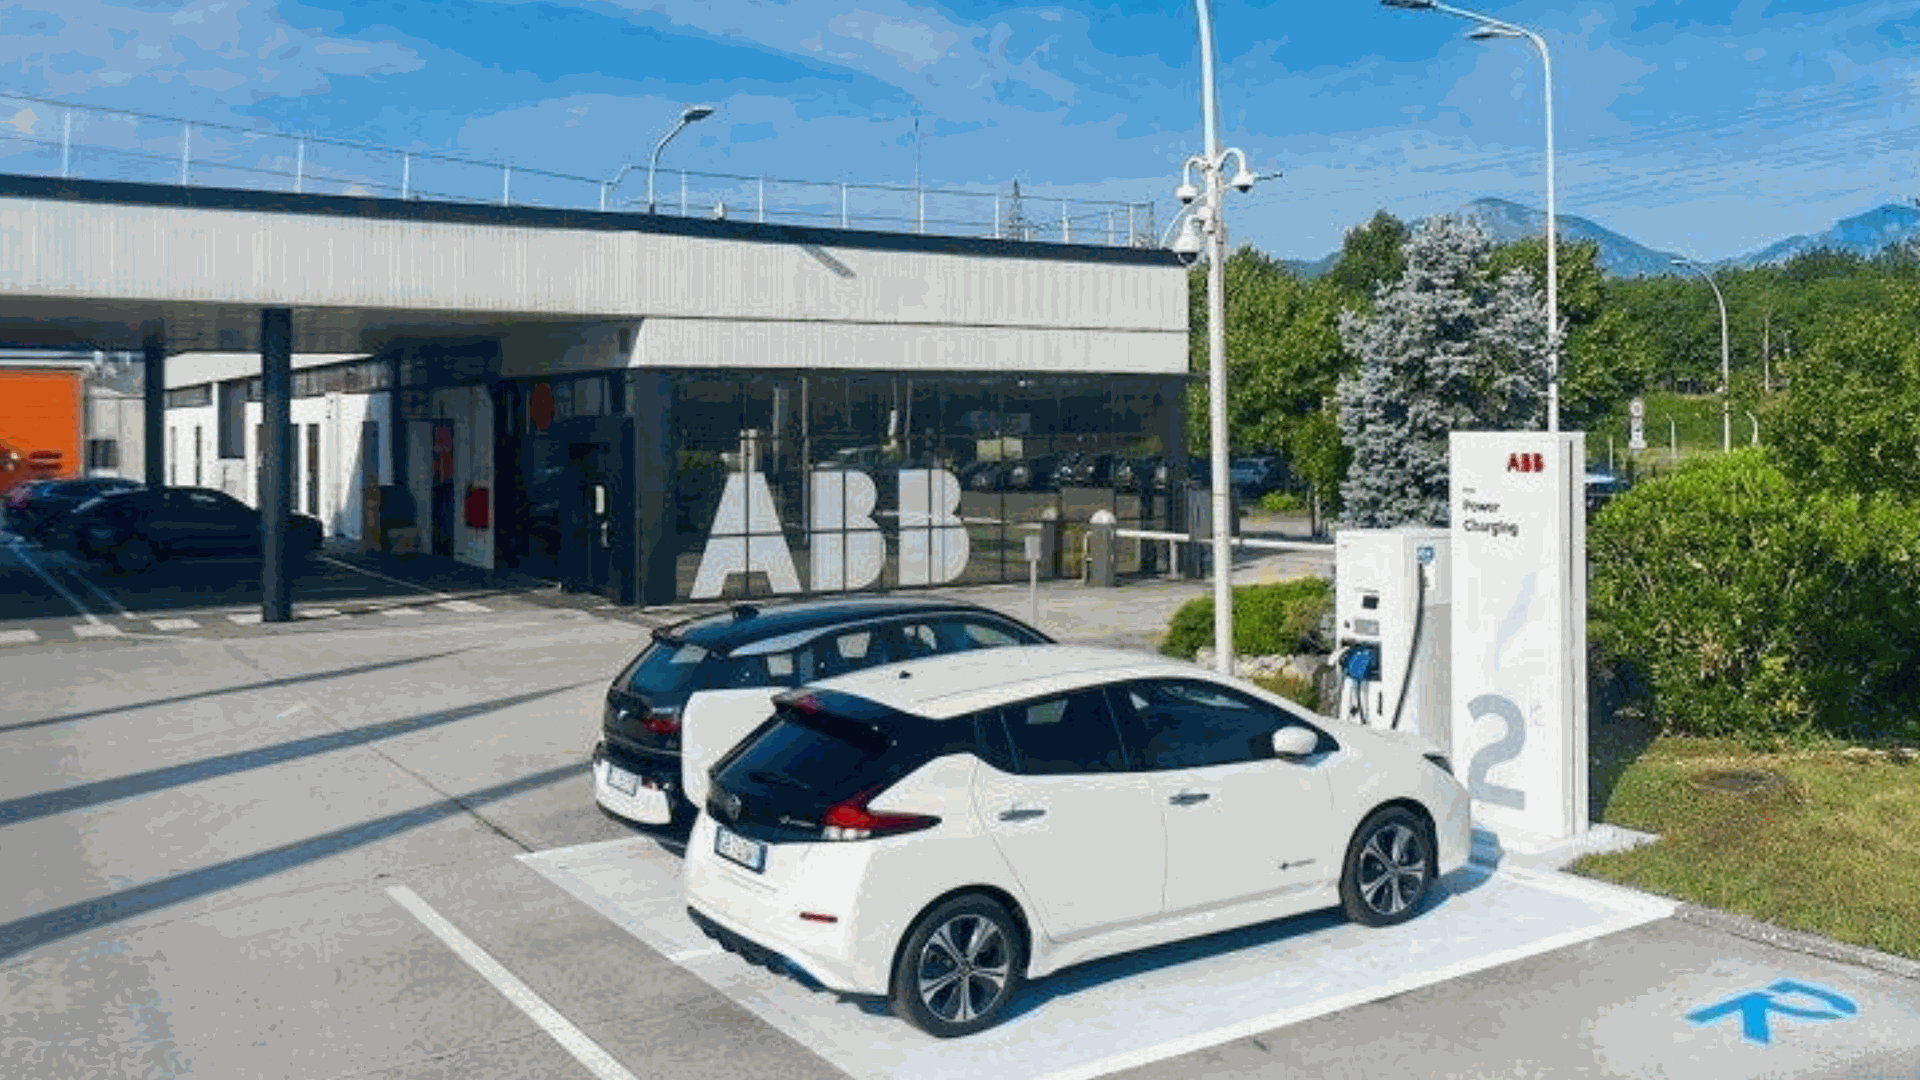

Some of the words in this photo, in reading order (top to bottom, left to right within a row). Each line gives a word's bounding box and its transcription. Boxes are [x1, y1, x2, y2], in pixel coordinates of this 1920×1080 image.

[1507, 452, 1544, 473] ABB
[1463, 500, 1500, 513] Power
[689, 468, 970, 599] ABB
[1463, 519, 1519, 537] Charging
[1467, 695, 1527, 811] 2
